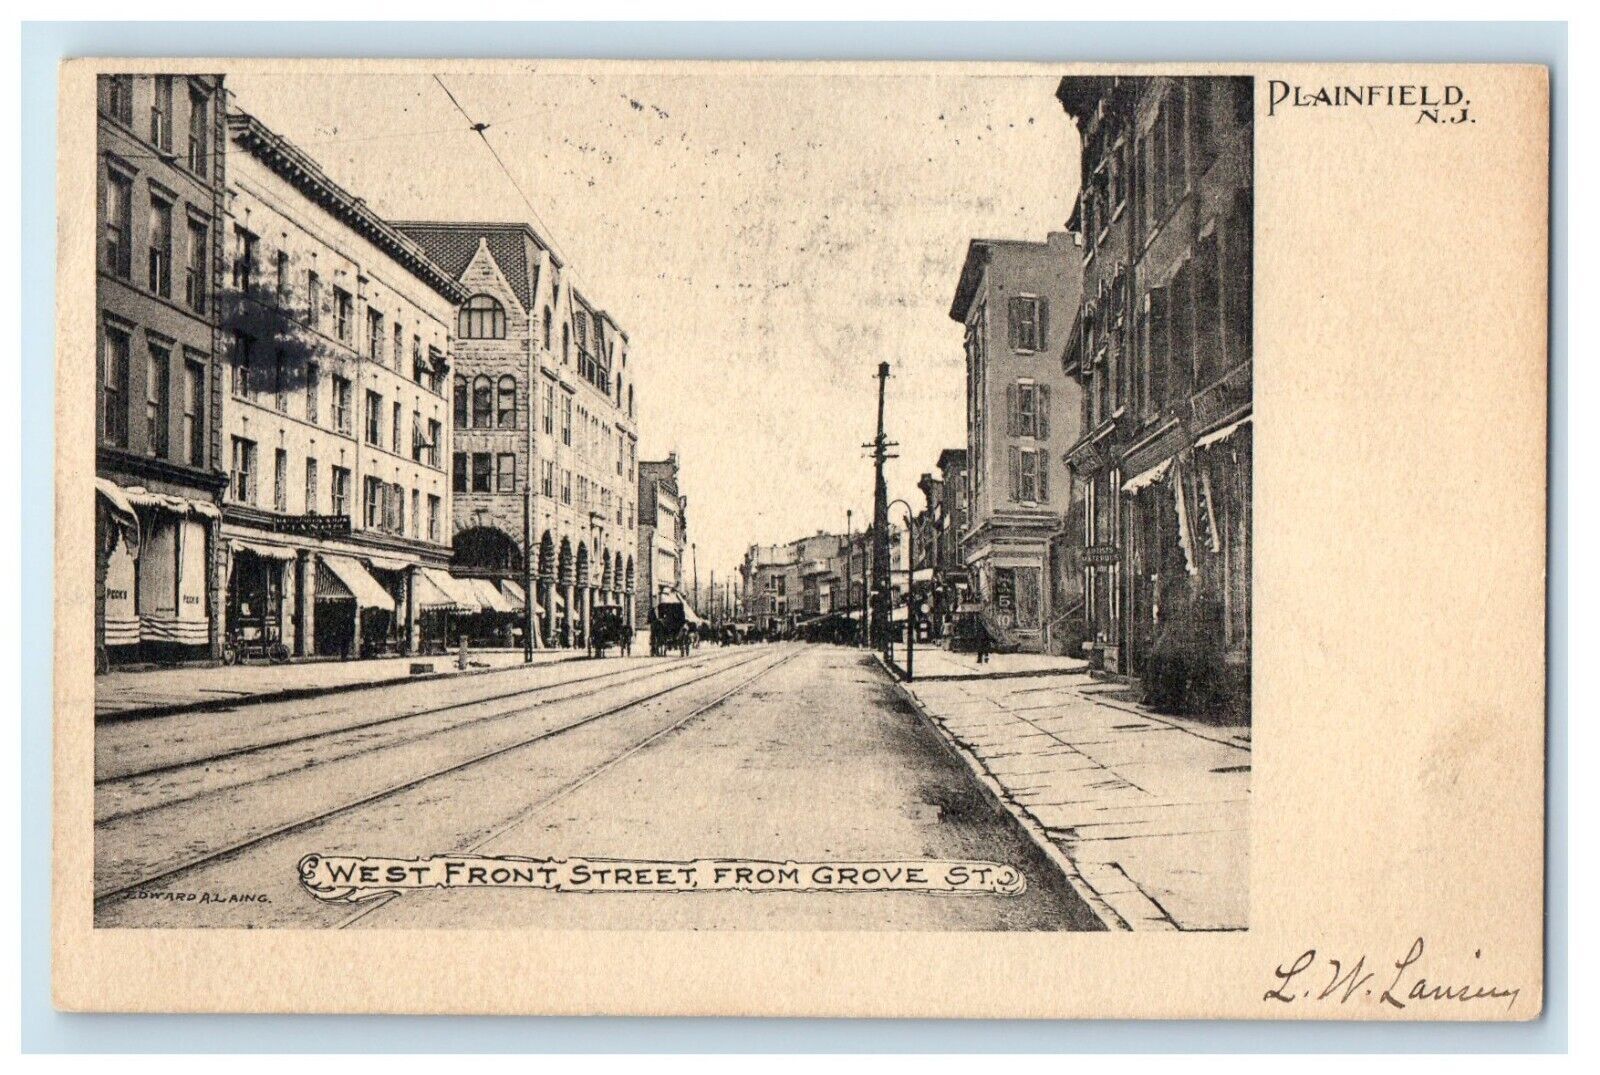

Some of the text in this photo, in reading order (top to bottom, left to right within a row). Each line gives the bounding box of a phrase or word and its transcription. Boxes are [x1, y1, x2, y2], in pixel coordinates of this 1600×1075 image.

[326, 861, 993, 888] WEST FRONT STREET, FROM GROVE ST.
[1317, 955, 1375, 1004] W.
